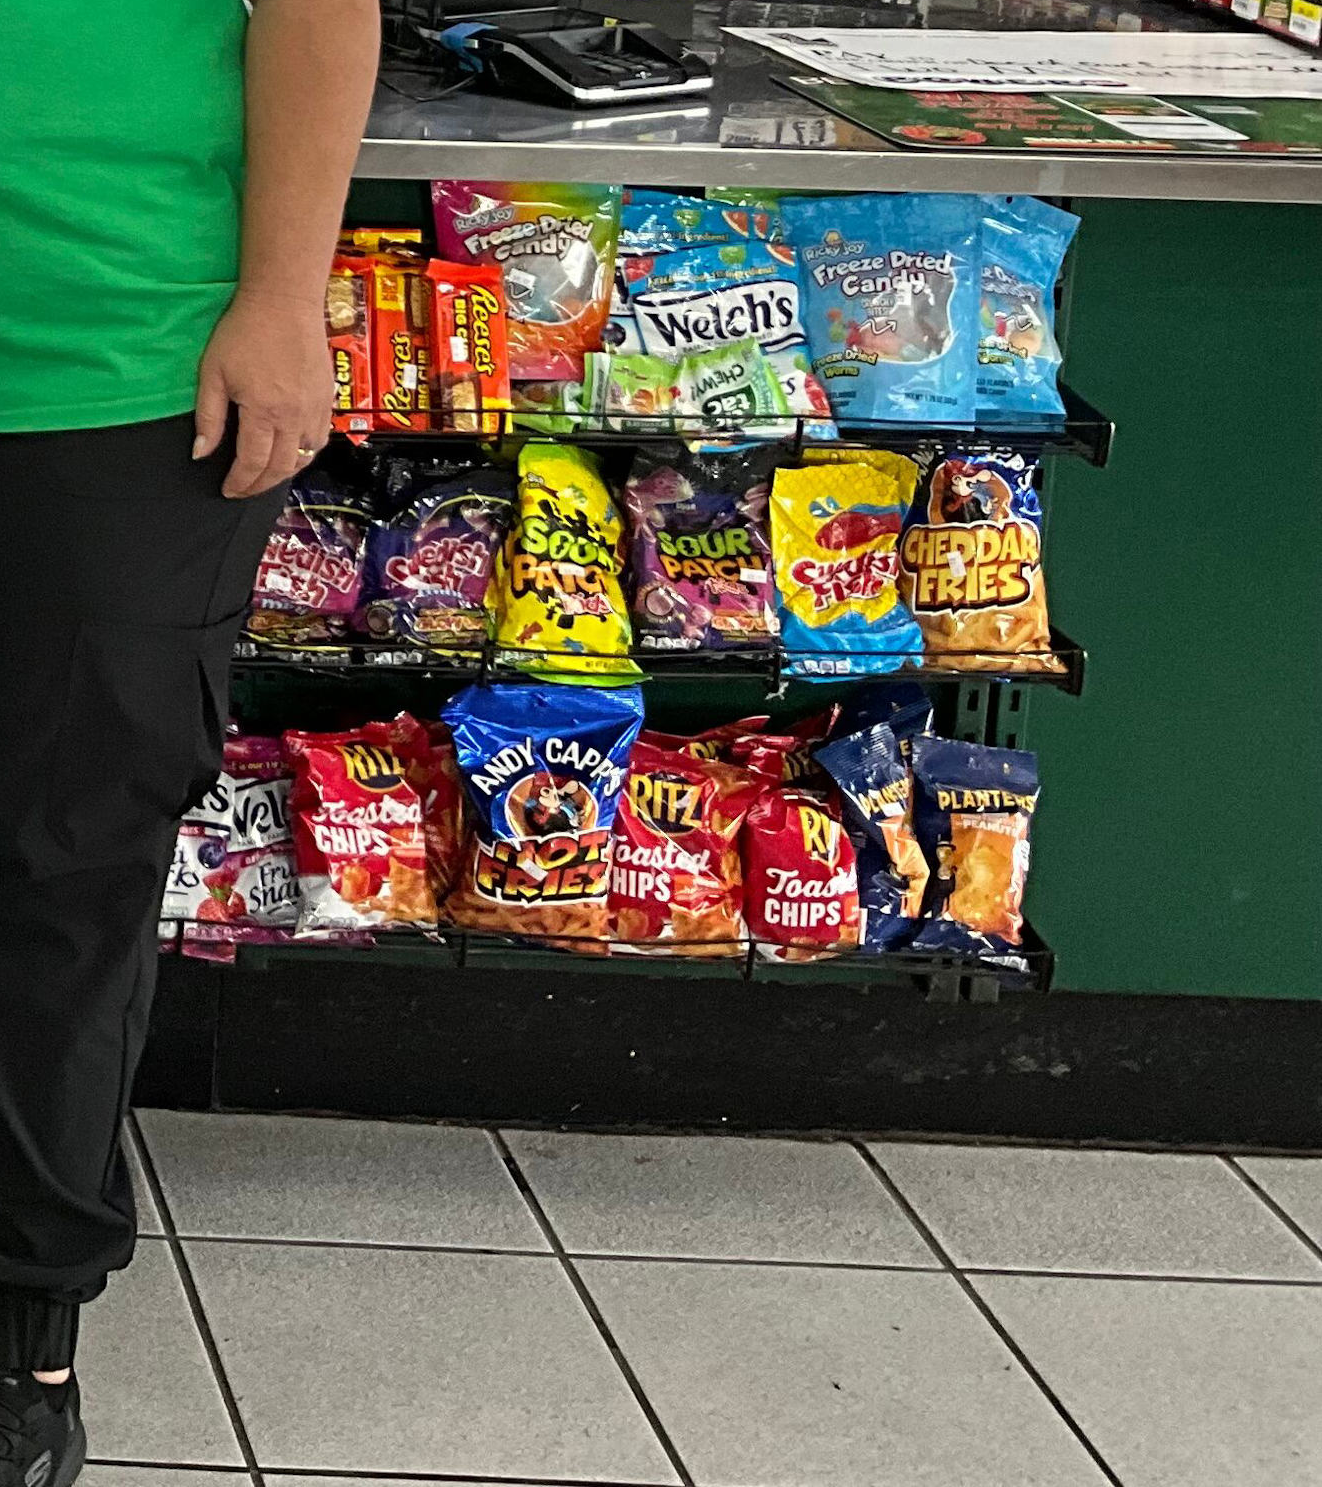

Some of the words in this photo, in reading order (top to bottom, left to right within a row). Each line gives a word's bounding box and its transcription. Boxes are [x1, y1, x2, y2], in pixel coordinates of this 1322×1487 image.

[464, 220, 537, 256] Freeze
[537, 216, 594, 240] Dried
[494, 237, 573, 261] Candy
[812, 257, 886, 287] Freeze
[889, 251, 953, 275] Dried
[841, 270, 926, 296] Candy
[468, 284, 500, 378] Reese's
[645, 294, 794, 345] Welch's
[522, 516, 620, 574] SOUR
[658, 529, 751, 557] SOUR
[904, 528, 1039, 565] CHEDDAR
[660, 554, 765, 582] PATCH
[918, 566, 1028, 602] FRIES
[472, 741, 536, 795] ANDY
[313, 795, 424, 824] Toasted
[629, 774, 704, 829] RITZ
[938, 789, 1036, 814] PLANTERS
[314, 825, 391, 855] CHIPS
[494, 833, 606, 865] HOT
[476, 861, 609, 897] FRIES
[764, 899, 841, 927] CHIPS
